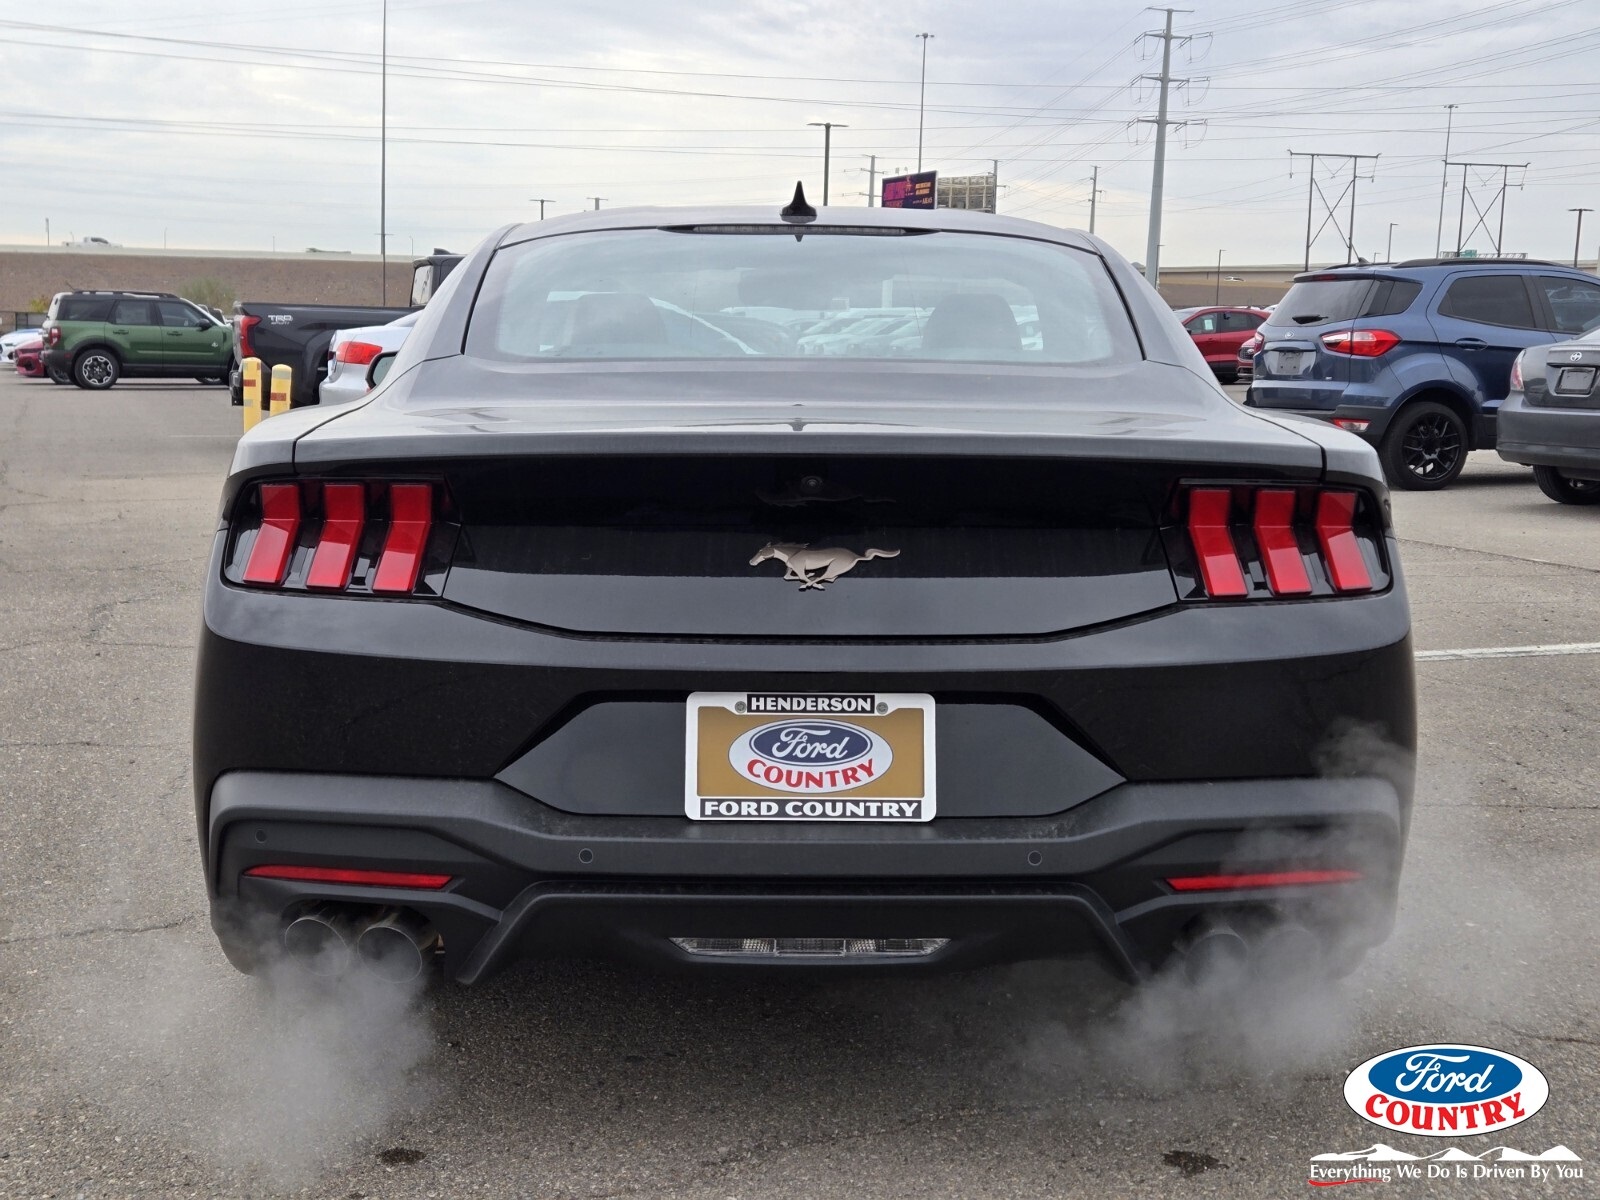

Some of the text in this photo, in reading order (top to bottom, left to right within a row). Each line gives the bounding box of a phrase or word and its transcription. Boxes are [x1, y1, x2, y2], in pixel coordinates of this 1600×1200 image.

[750, 697, 872, 712] HENDERSON
[771, 727, 849, 759] Ford
[747, 758, 875, 788] COUNTRY
[704, 801, 918, 817] FORD COUNTRY
